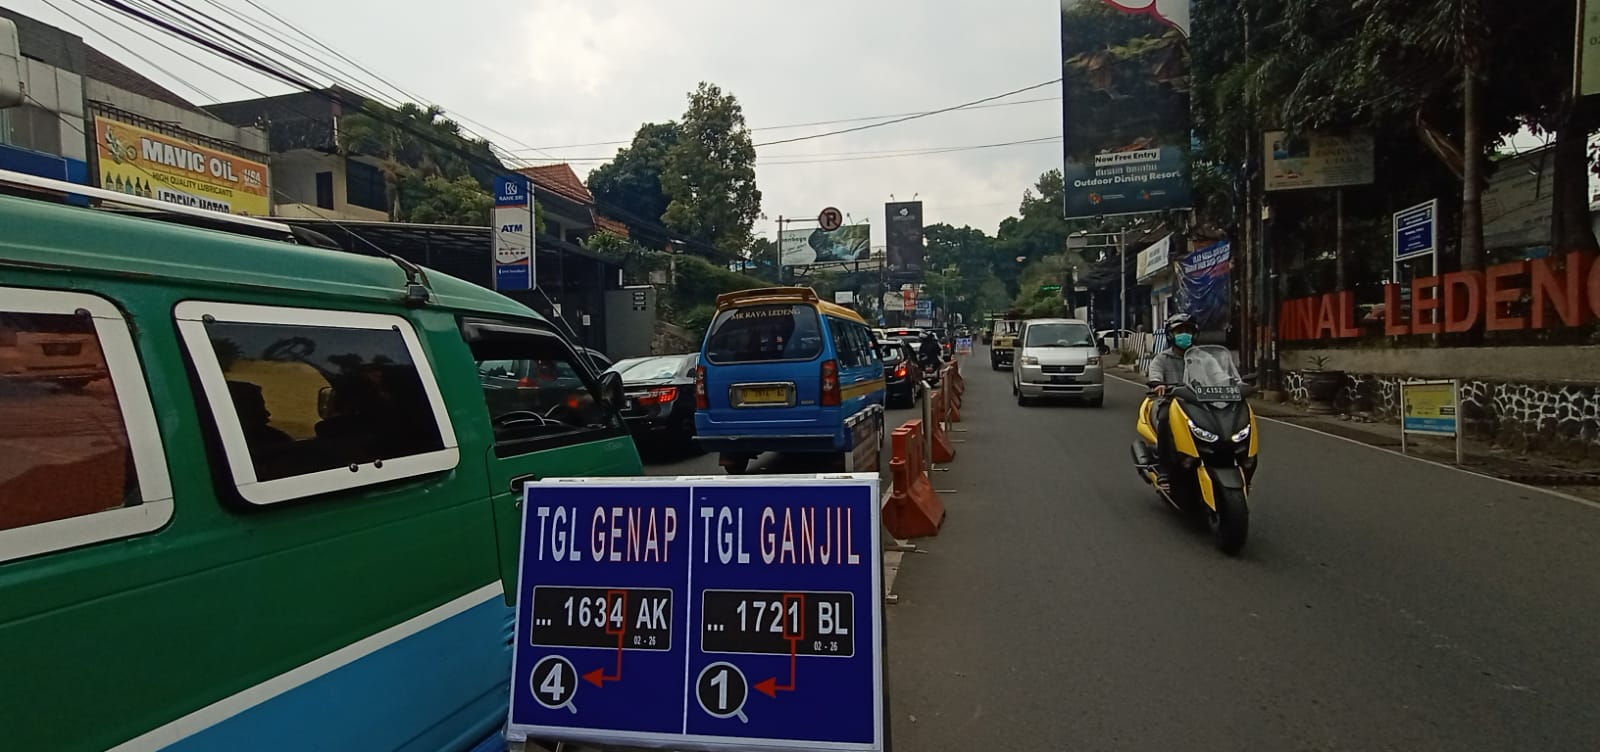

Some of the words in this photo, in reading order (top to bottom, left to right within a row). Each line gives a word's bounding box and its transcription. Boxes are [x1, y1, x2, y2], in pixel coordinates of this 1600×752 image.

[141, 137, 206, 173] MAVIC
[243, 168, 261, 185] USA
[1133, 151, 1157, 160] Entry
[152, 171, 169, 182] HIGH
[169, 175, 196, 190] QUALITY
[197, 182, 233, 199] LUBRICANTS
[1074, 178, 1112, 188] Outdoor
[1114, 174, 1148, 184] Dining
[1149, 171, 1181, 180] Resort
[501, 224, 523, 233] ATM
[746, 311, 767, 320] RAYA
[768, 308, 800, 316] LEDENG
[537, 506, 582, 563] TGL
[591, 506, 678, 563] GENAP
[700, 506, 750, 565] TGL
[760, 506, 861, 565] GANJIL
[564, 595, 624, 628] 1634
[636, 598, 669, 630] AK
[736, 600, 800, 634] 1721
[818, 602, 848, 636] BL
[633, 635, 643, 645] 02
[648, 636, 656, 646] 26
[814, 641, 822, 651] 02
[830, 642, 838, 652] 26
[540, 663, 566, 702] 4
[710, 670, 728, 710] 1
